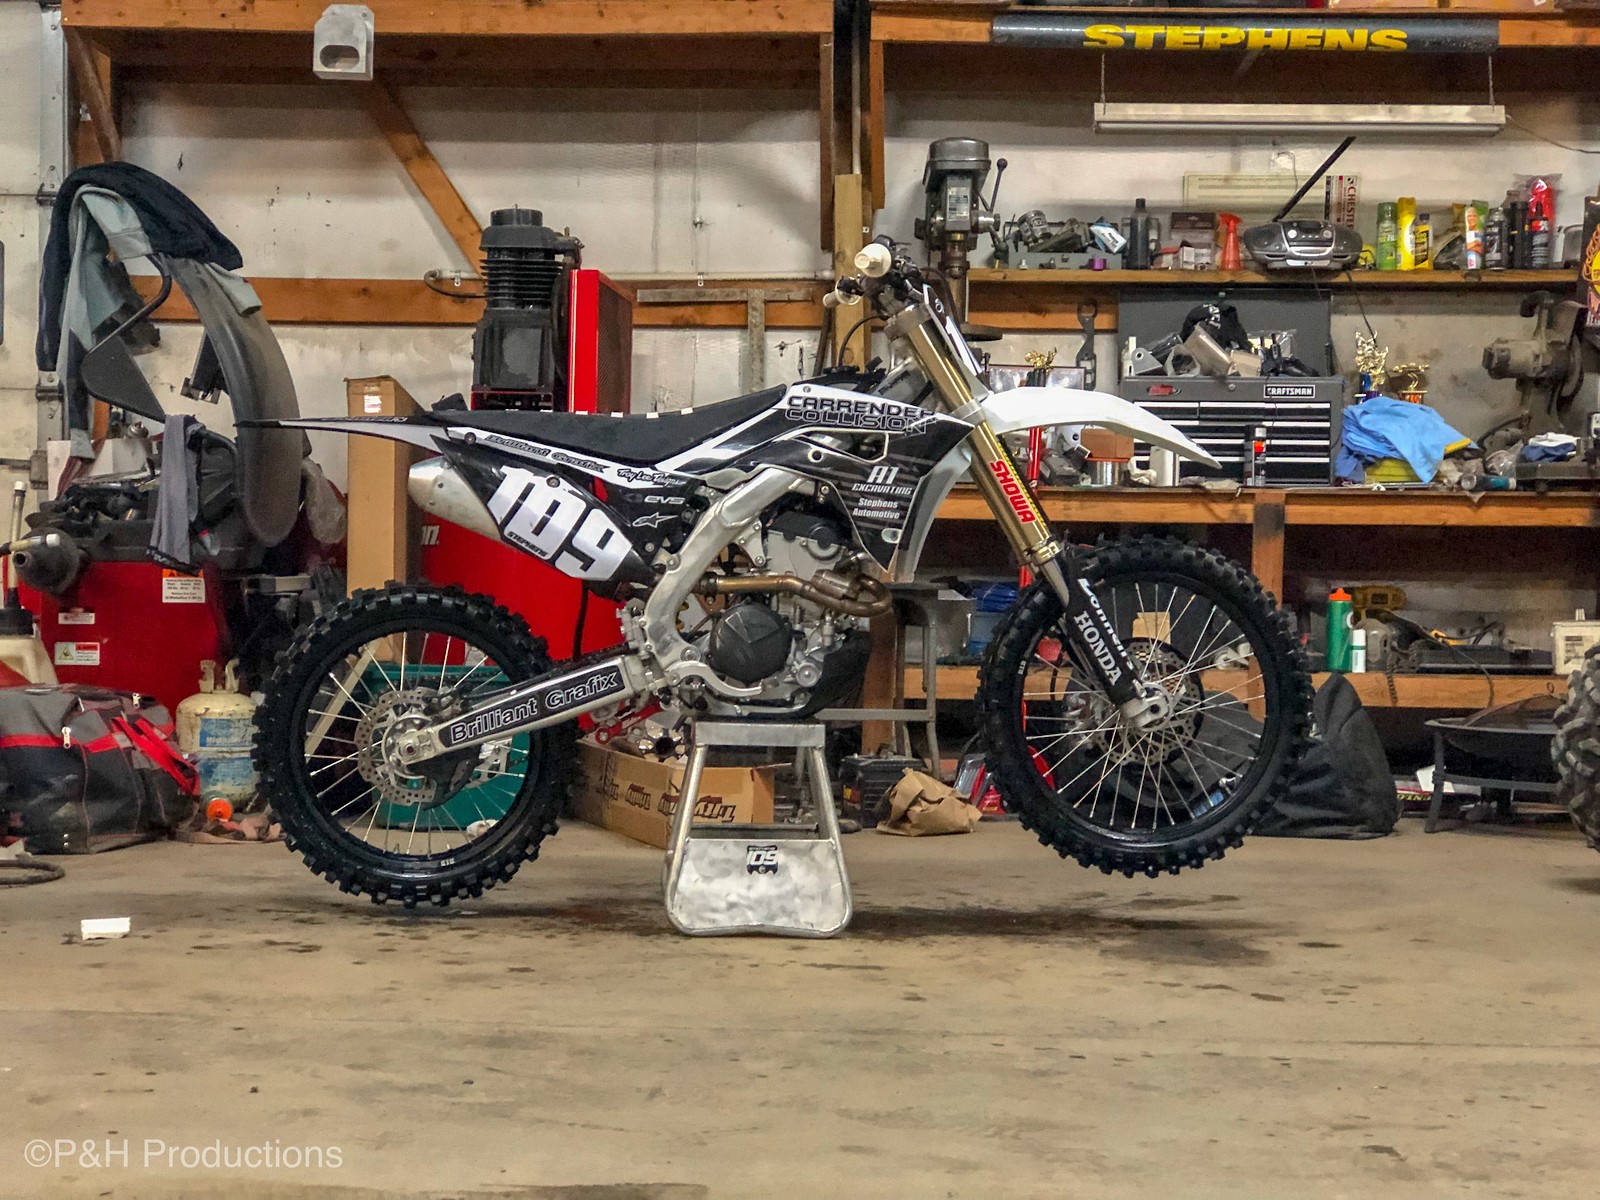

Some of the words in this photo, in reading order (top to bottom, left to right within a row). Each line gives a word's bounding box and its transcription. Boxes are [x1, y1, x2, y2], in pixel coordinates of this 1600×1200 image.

[1083, 24, 1408, 51] STEPHENS
[1266, 386, 1313, 397] CRAFTSMAN
[784, 408, 928, 435] COLLISION
[867, 465, 900, 485] A1
[851, 483, 913, 496] EXCAVATING
[988, 459, 1037, 524] SHOWA
[852, 507, 901, 520] Automotive
[858, 497, 899, 509] Stephens
[487, 465, 633, 580] 109
[1073, 610, 1123, 687] HONDA
[450, 697, 539, 745] Brilliant
[544, 670, 618, 710] Grafix
[746, 850, 779, 866] 109
